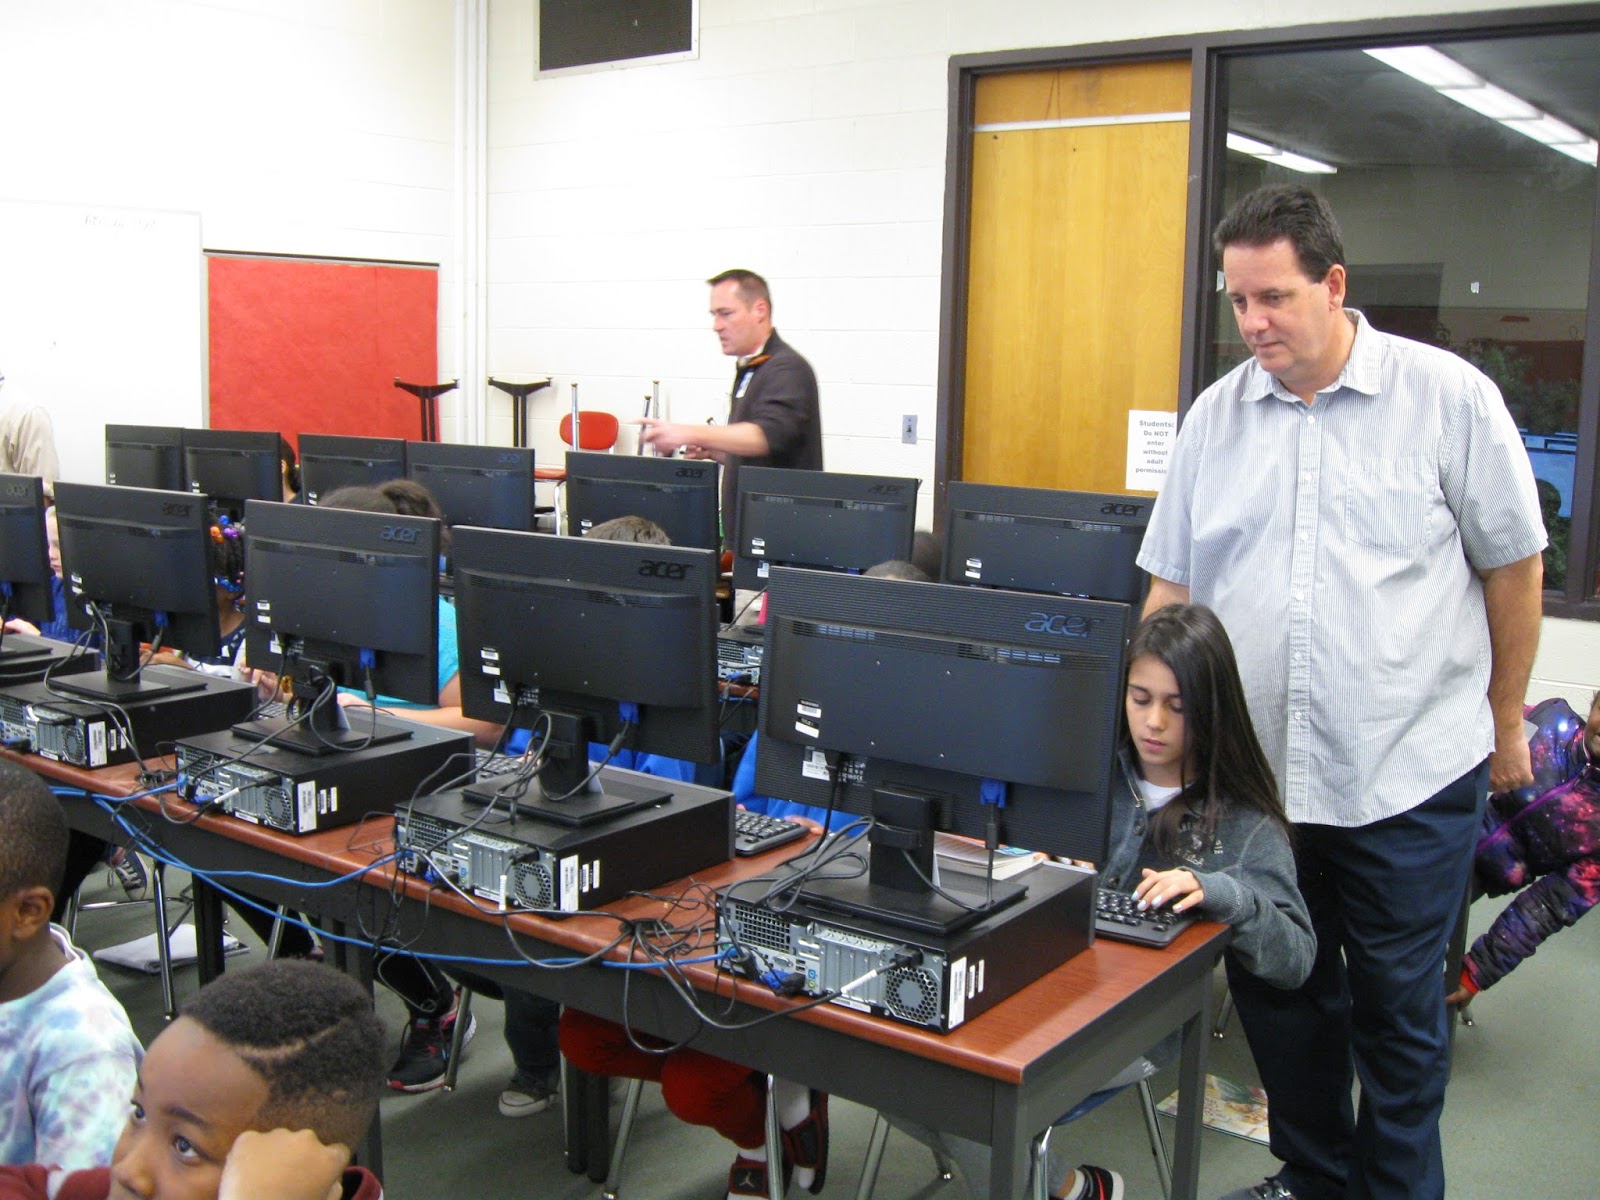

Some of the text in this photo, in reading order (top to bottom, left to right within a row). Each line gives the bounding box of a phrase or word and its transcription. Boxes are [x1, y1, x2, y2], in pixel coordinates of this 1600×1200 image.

[1139, 420, 1174, 428] Students:
[675, 467, 706, 478] acer
[1135, 467, 1168, 475] permissio
[1100, 502, 1145, 518] acer
[379, 524, 421, 543] acer
[638, 559, 694, 580] acer
[1024, 611, 1101, 638] acer
